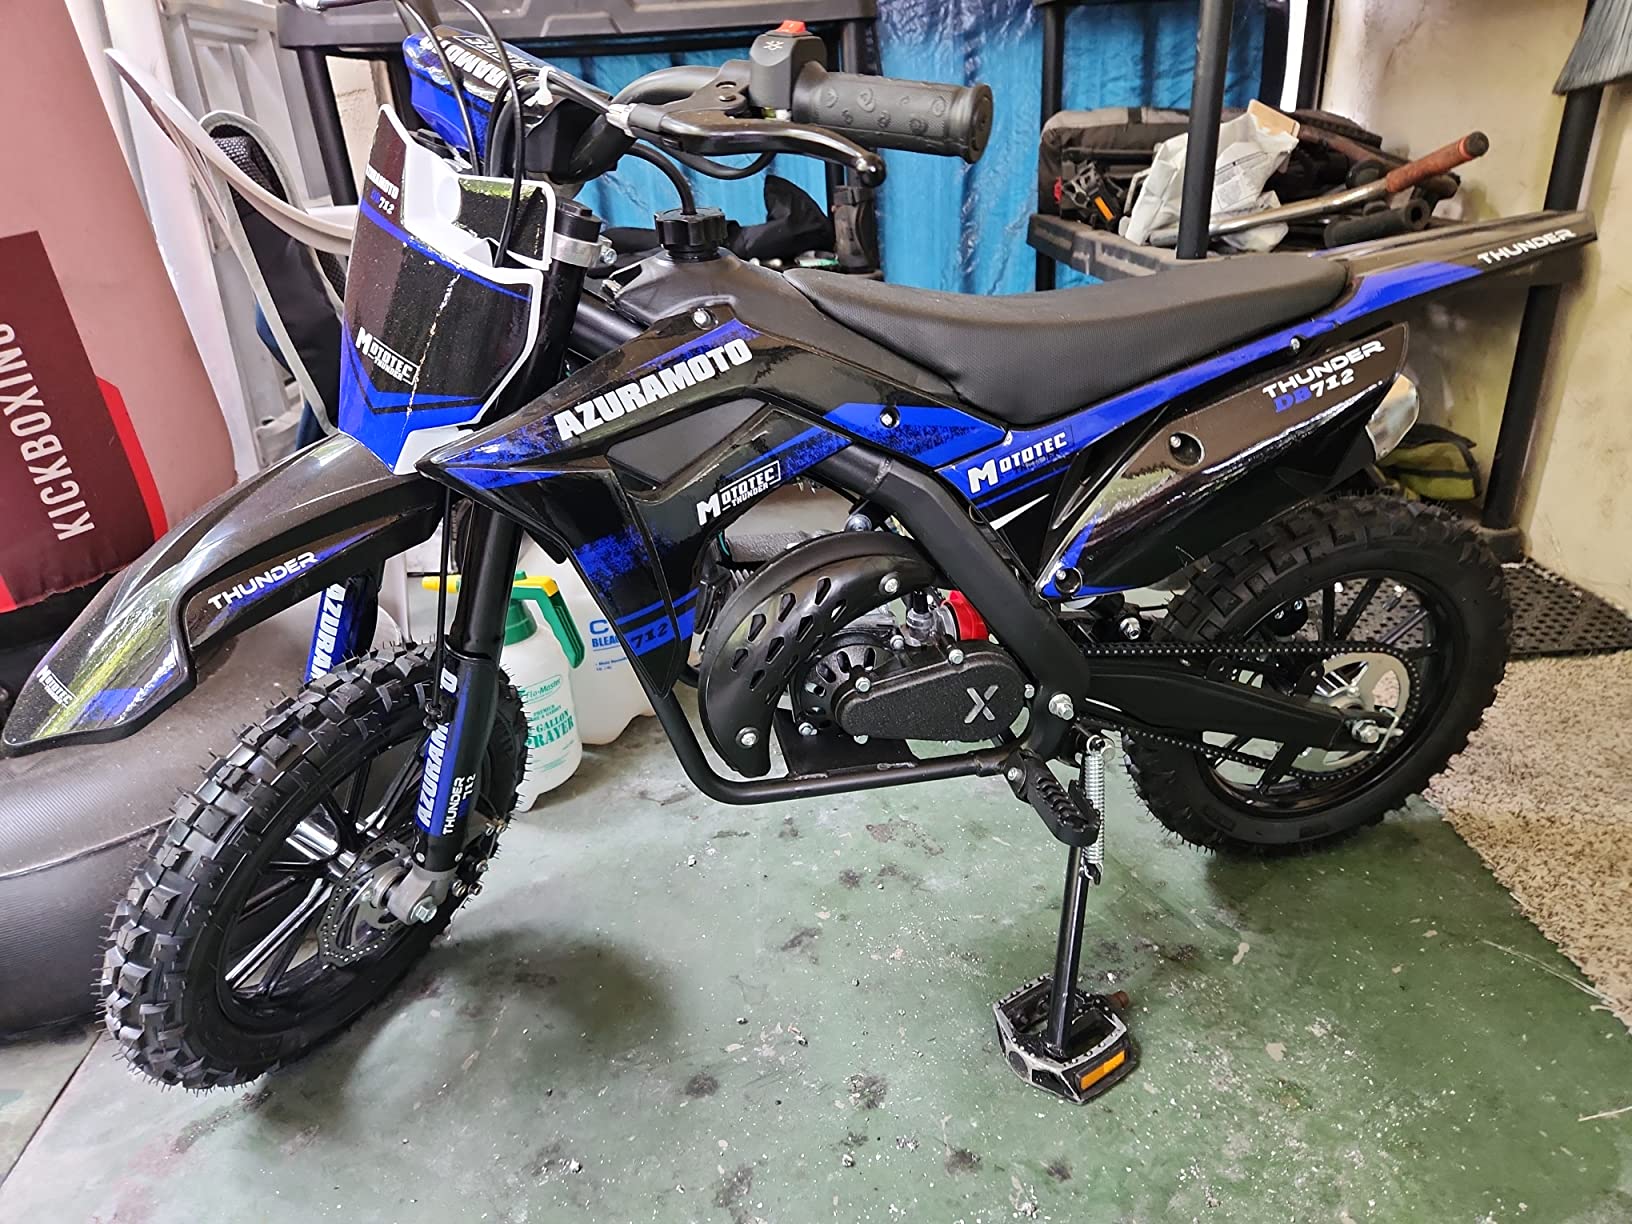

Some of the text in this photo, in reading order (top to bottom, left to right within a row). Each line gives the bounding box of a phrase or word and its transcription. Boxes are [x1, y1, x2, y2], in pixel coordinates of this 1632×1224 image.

[1477, 229, 1576, 264] THUNDER
[355, 326, 413, 378] MOTOTEC
[1262, 340, 1385, 398] THUNDER
[553, 338, 753, 441] AZURAMOTO
[1274, 368, 1355, 413] DB712
[967, 431, 1068, 494] MOTOTEC
[696, 467, 775, 526] MOTOTEC
[731, 482, 769, 507] THUNDER
[207, 551, 319, 610] THUNDER
[592, 635, 619, 648] BLEA
[630, 622, 668, 649] 712
[443, 776, 465, 836] THUNDER
